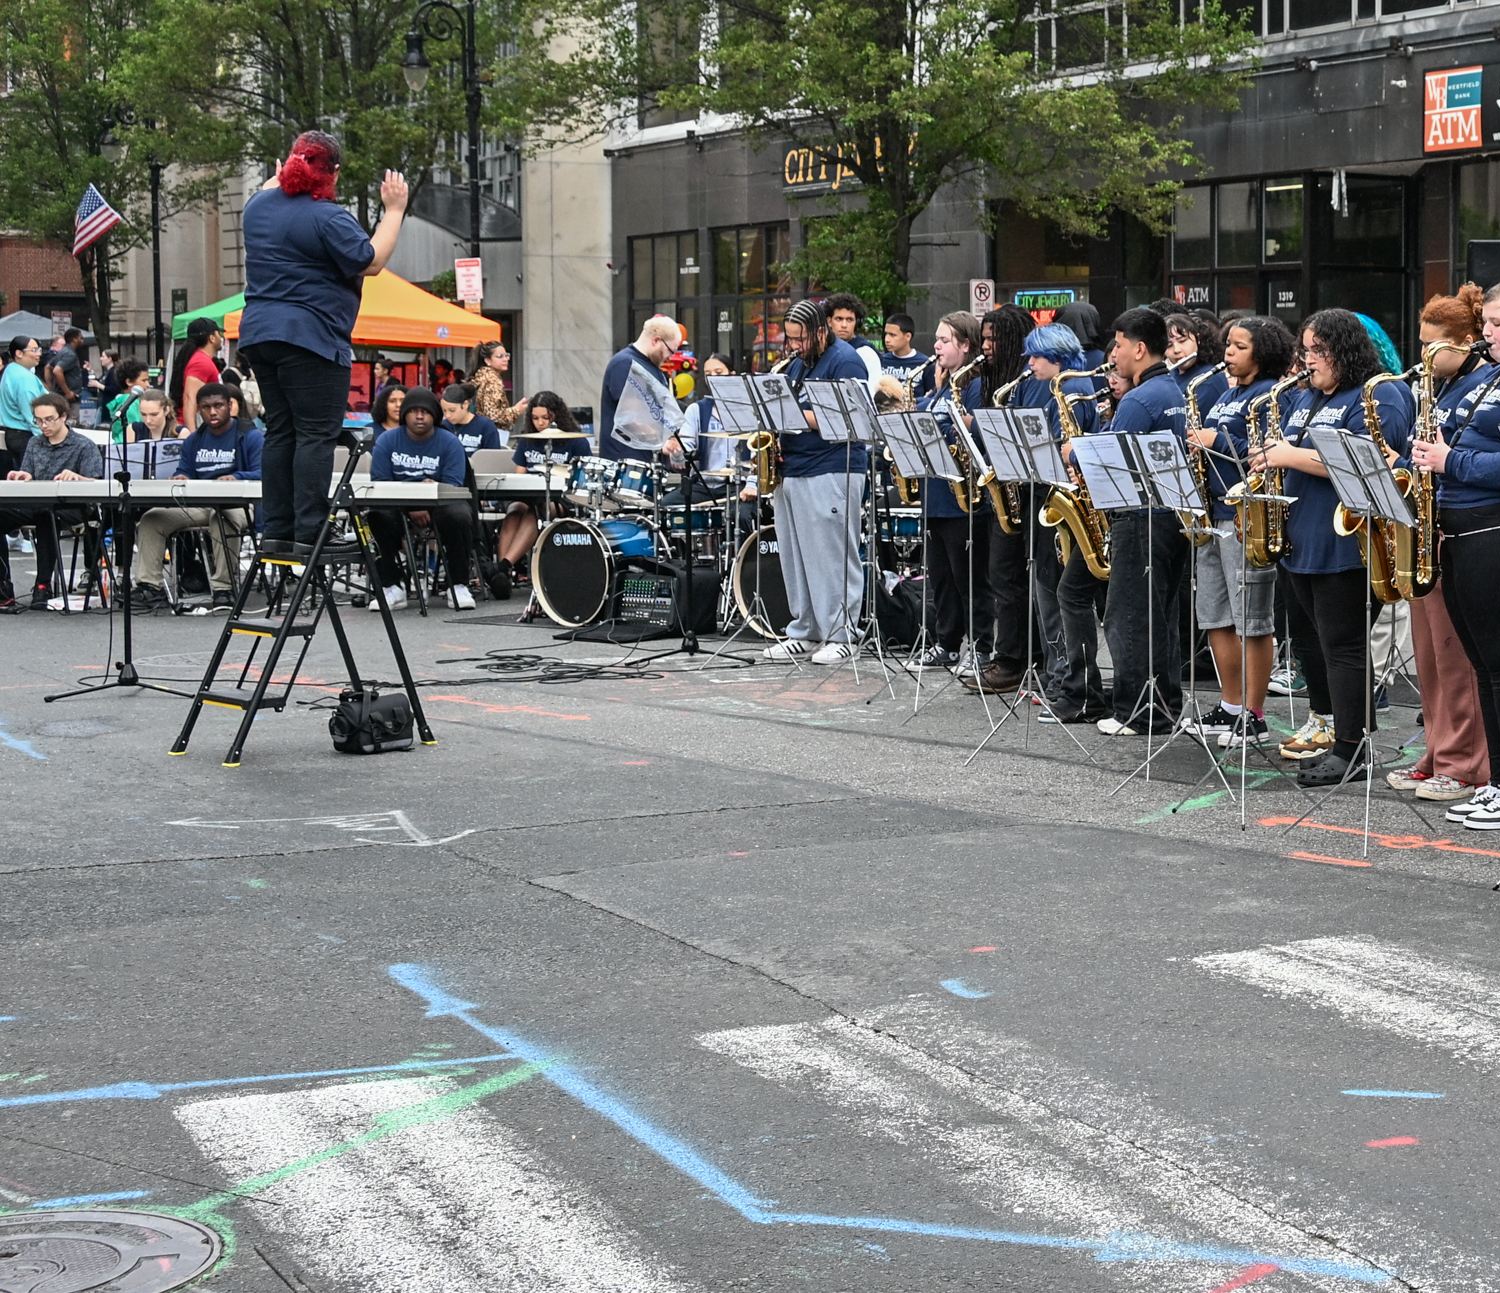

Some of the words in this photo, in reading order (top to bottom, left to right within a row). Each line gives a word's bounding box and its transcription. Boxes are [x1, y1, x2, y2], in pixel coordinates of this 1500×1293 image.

[1427, 109, 1478, 146] ATM
[1188, 287, 1209, 302] ATM
[1278, 291, 1294, 301] 1319
[562, 533, 592, 546] YAMAHA
